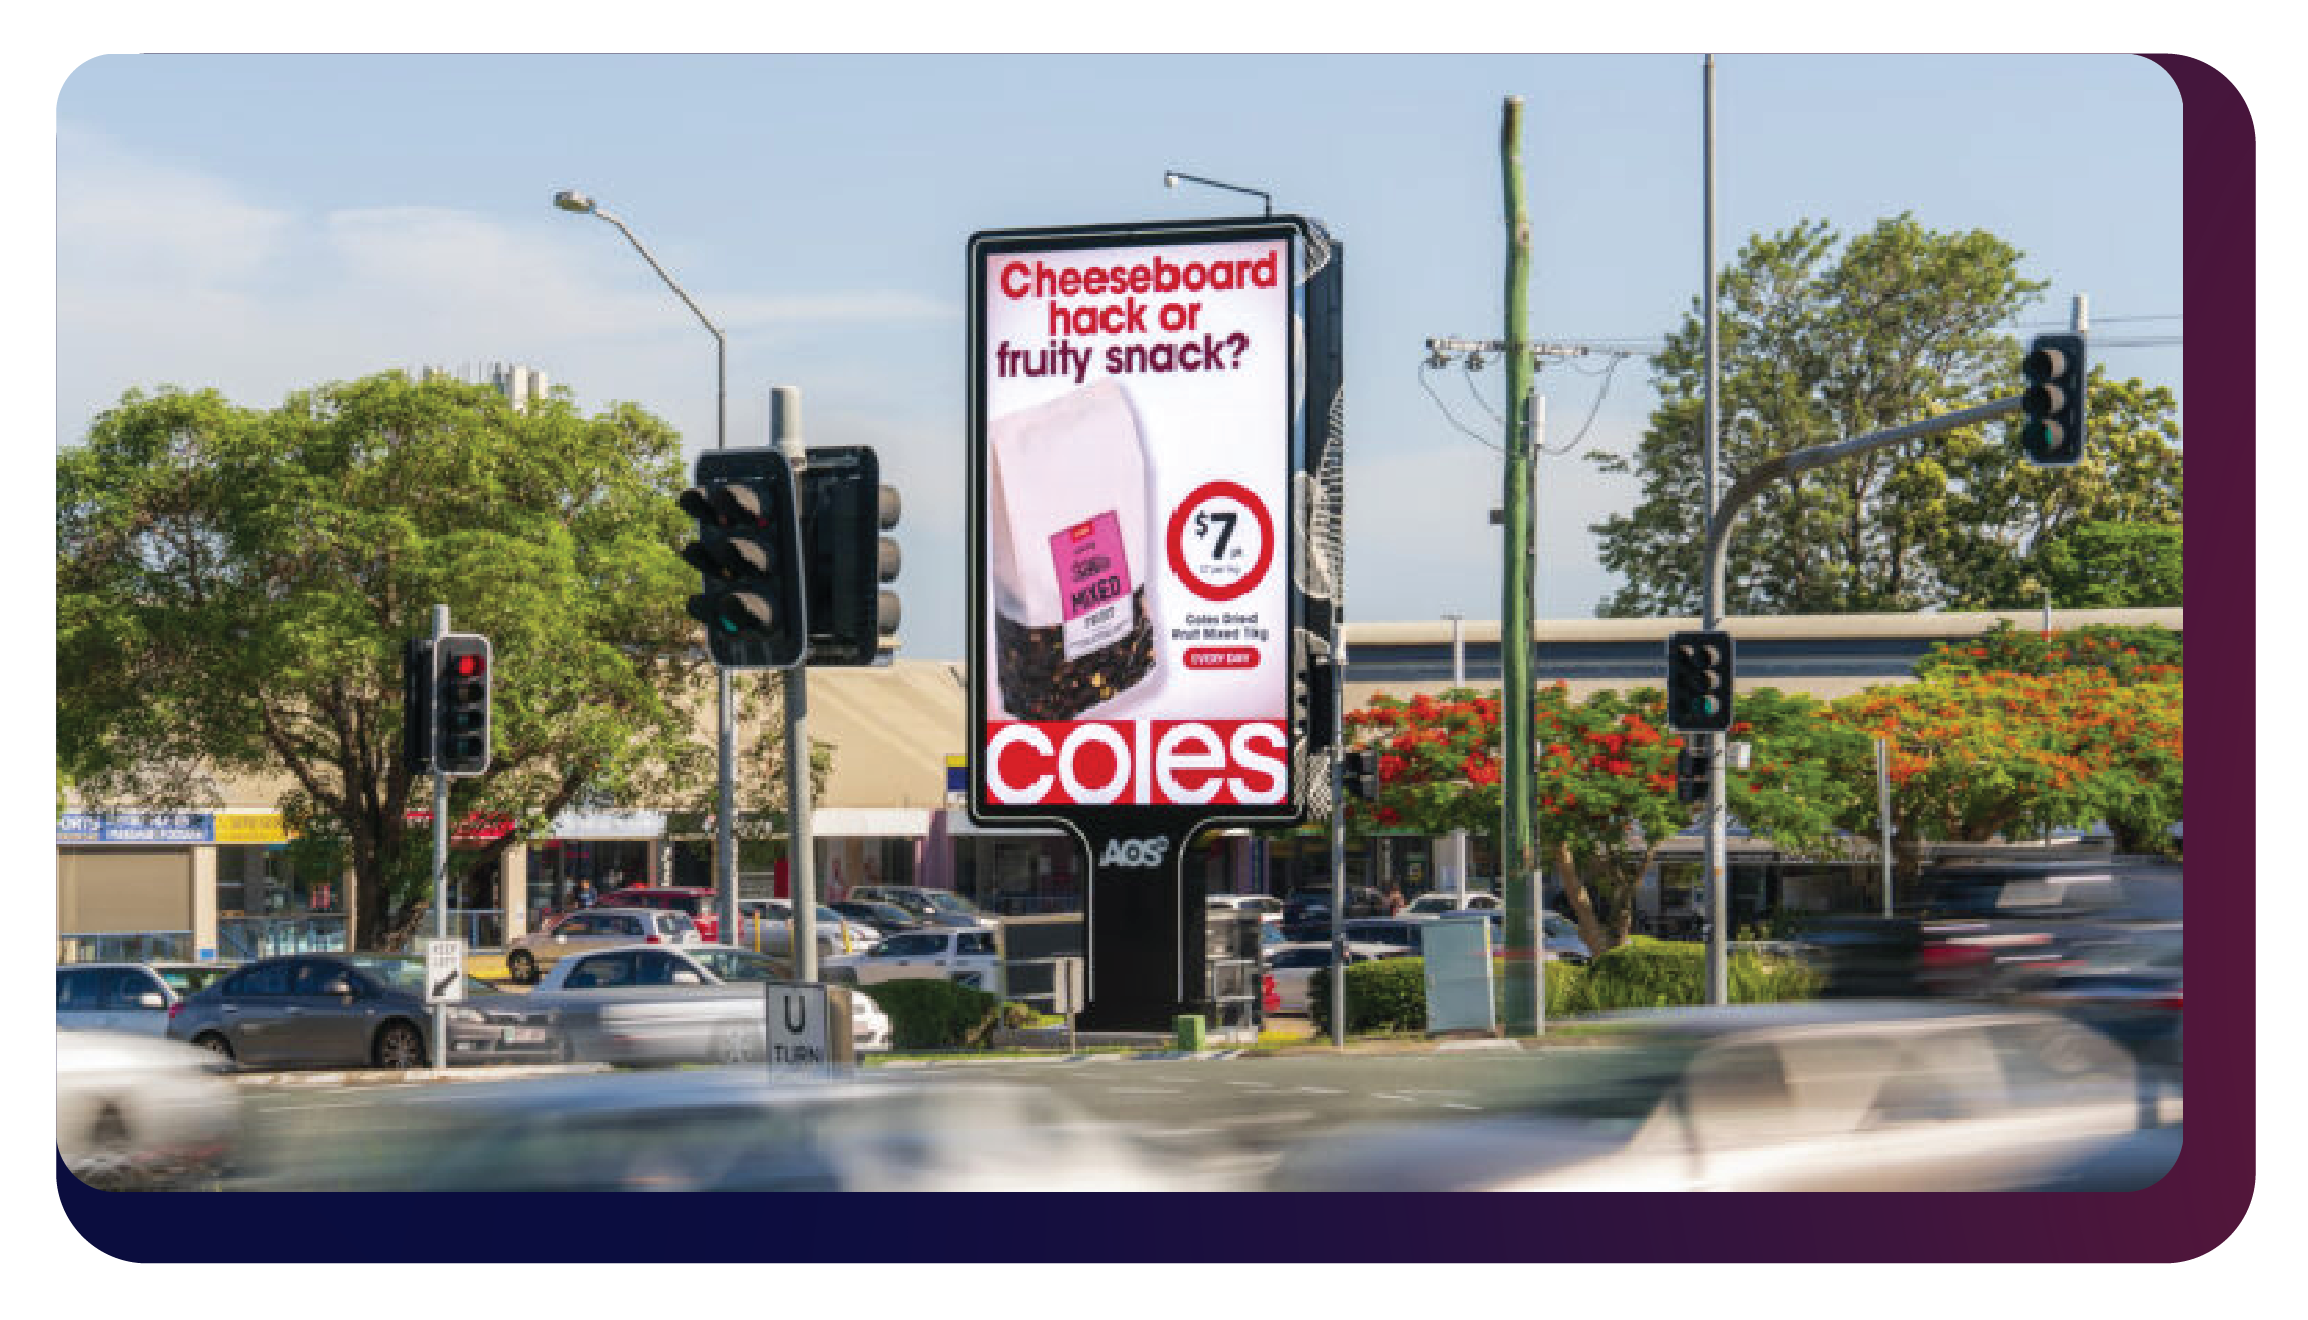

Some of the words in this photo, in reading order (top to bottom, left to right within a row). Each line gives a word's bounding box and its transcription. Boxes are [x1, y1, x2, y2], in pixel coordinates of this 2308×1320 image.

[1000, 250, 1277, 299] Cheeseboard
[1050, 297, 1147, 335] hack
[1159, 302, 1202, 331] or
[997, 341, 1092, 383] fruity
[1105, 331, 1250, 373] snack?
[987, 721, 1287, 804] coles
[784, 993, 807, 1035] U
[773, 1043, 821, 1066] TURN
